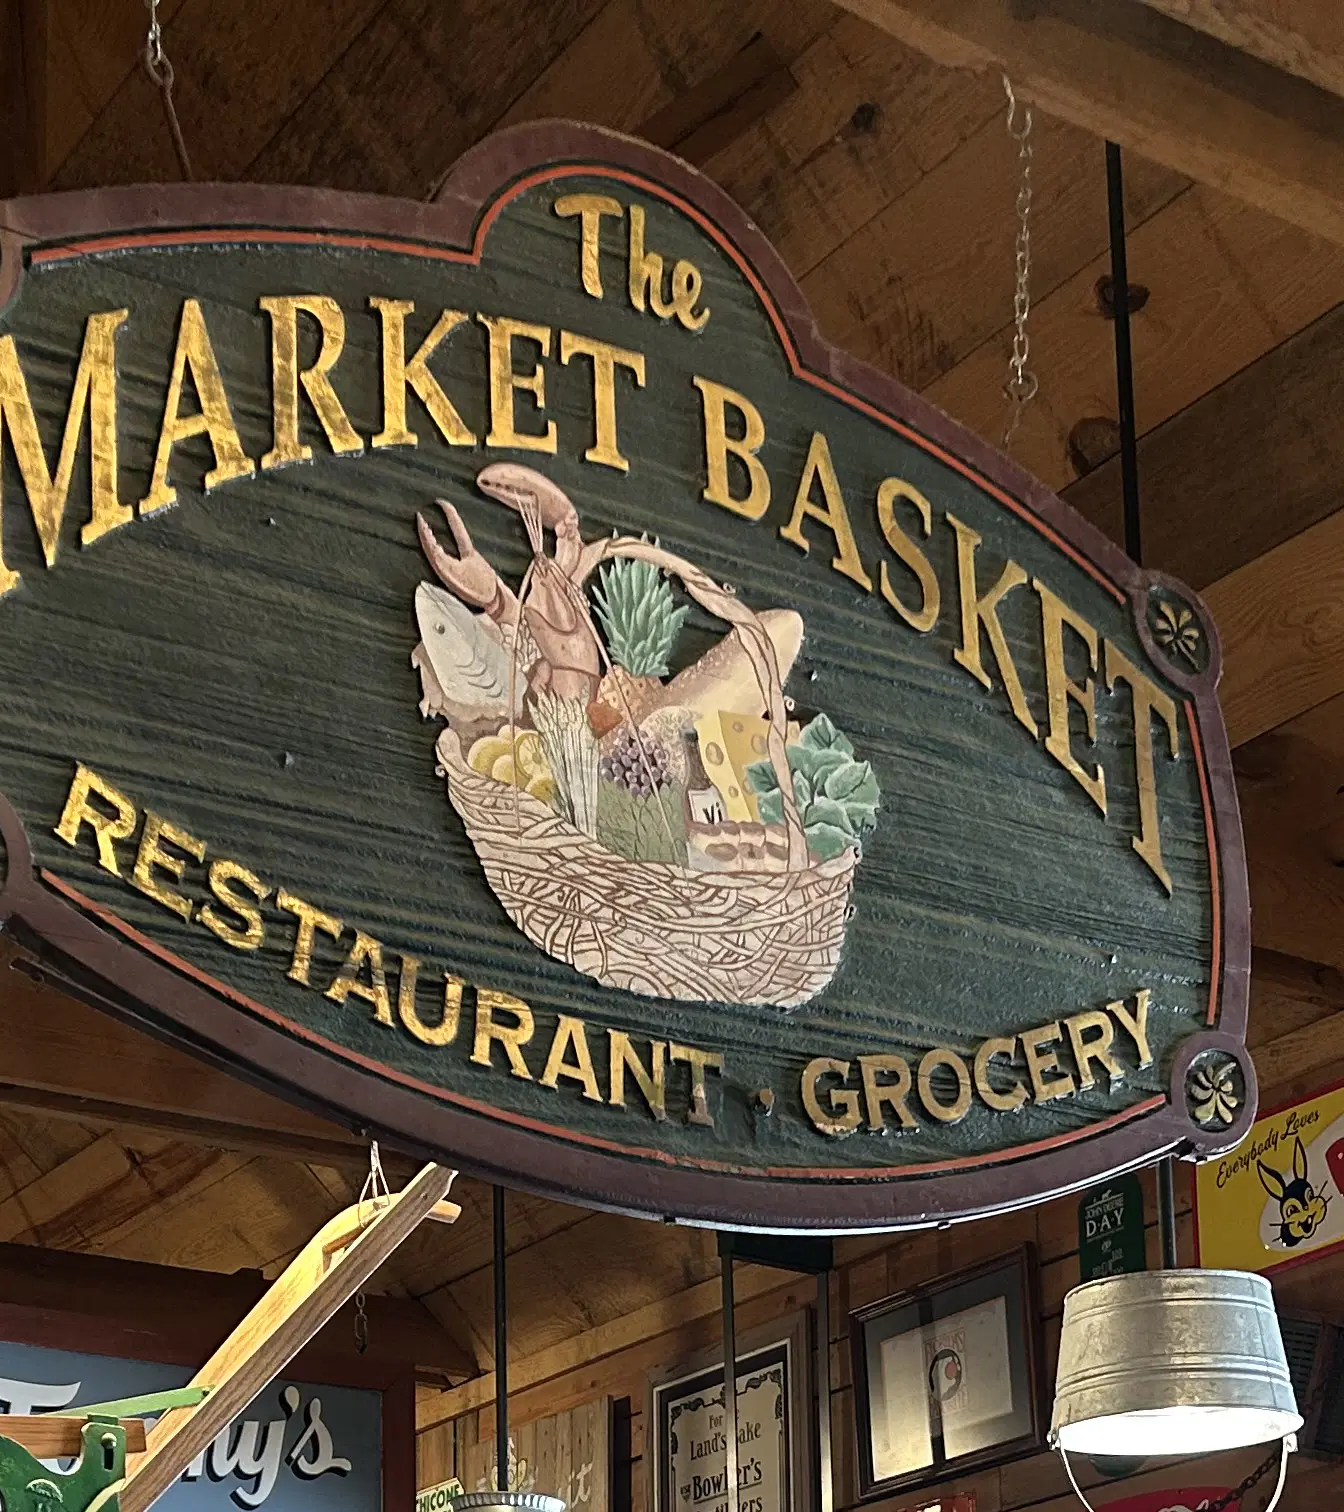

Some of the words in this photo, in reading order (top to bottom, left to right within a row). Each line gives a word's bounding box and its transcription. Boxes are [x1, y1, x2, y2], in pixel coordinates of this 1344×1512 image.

[553, 194, 711, 333] The
[691, 373, 1179, 897] BASKET
[54, 764, 723, 1126] RESTAURANT
[799, 989, 1154, 1135] GROCERY
[1216, 1131, 1280, 1188] Everybody
[1279, 1108, 1320, 1141] Loves
[690, 1431, 727, 1461] Land's
[709, 1412, 723, 1431] For
